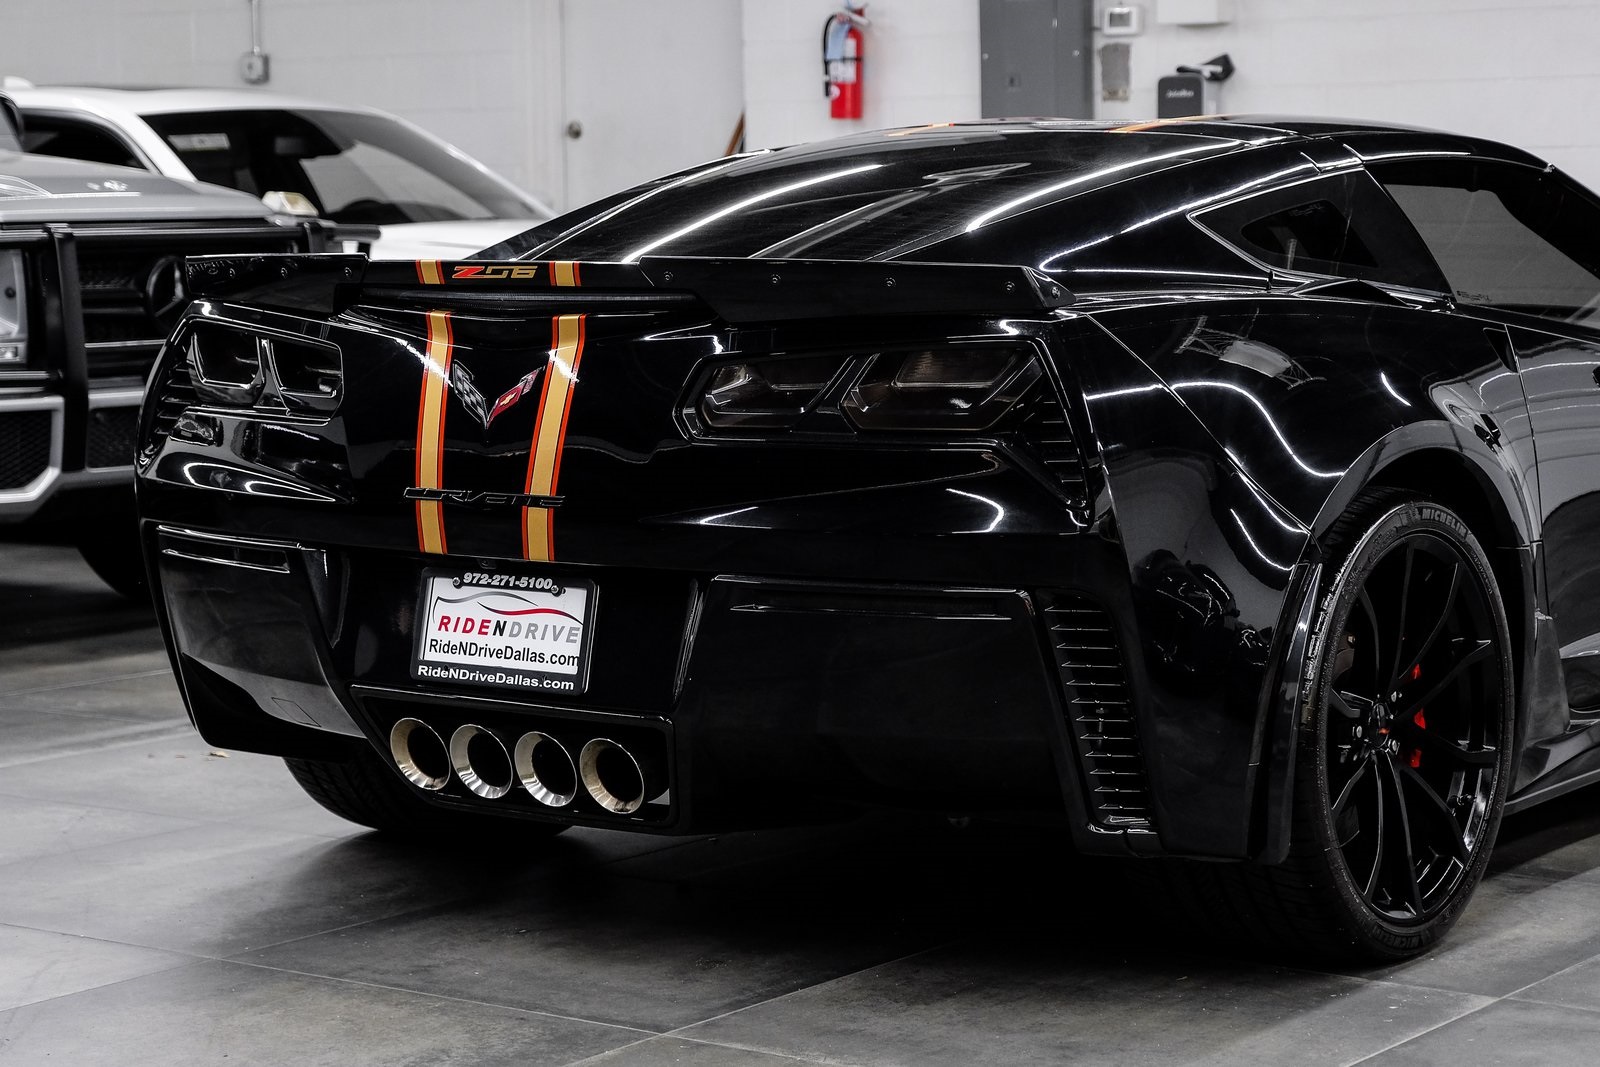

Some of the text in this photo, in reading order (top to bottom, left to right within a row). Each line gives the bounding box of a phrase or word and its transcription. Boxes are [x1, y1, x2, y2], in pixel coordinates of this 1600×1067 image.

[452, 265, 538, 279] Z06
[1421, 508, 1468, 538] MICHELIN
[462, 572, 553, 590] 972-271-5100
[428, 638, 580, 667] RideNDriveDallas.com
[417, 664, 575, 691] RideNDriveDallas.com
